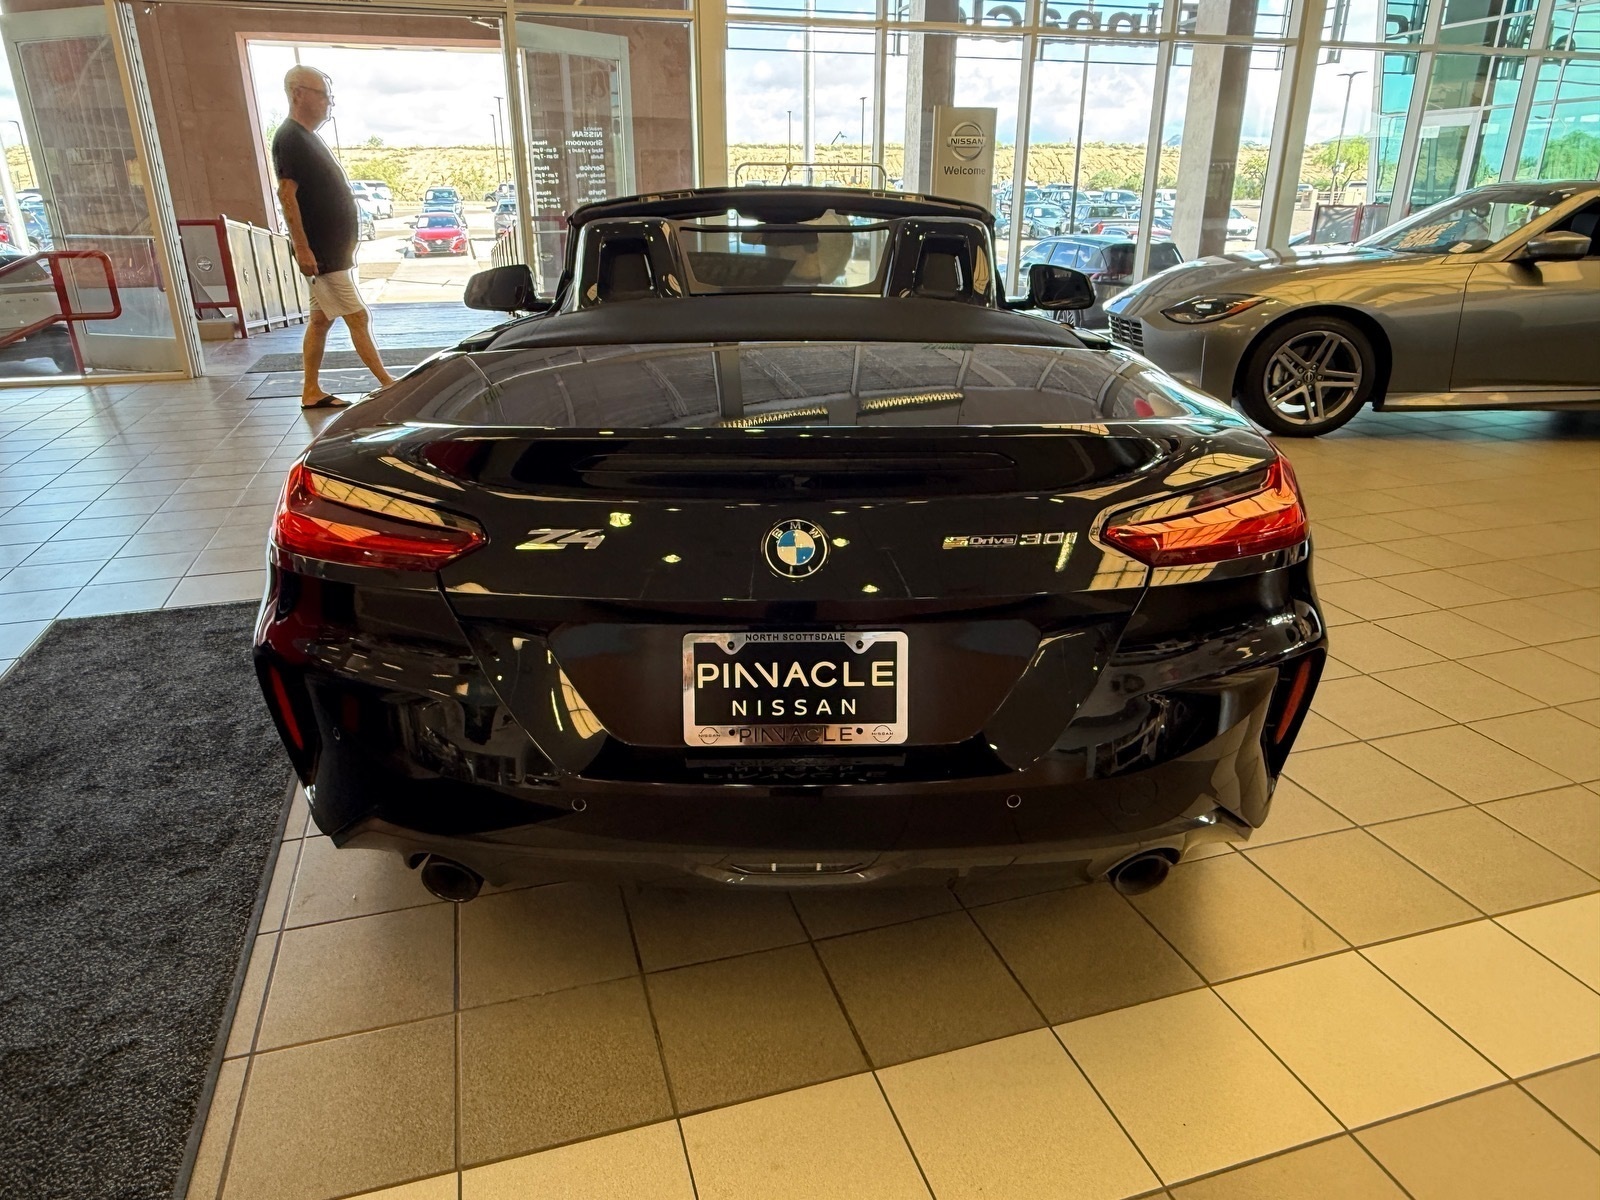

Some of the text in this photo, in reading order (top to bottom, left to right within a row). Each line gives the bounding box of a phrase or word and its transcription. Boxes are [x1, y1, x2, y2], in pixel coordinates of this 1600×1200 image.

[944, 166, 986, 175] Welcome
[515, 529, 605, 549] Z4
[745, 633, 846, 641] NORTH SCOTTSDALE
[697, 661, 894, 688] PINNACLE
[732, 699, 856, 716] NISSAN
[739, 727, 853, 743] PINNACLE
